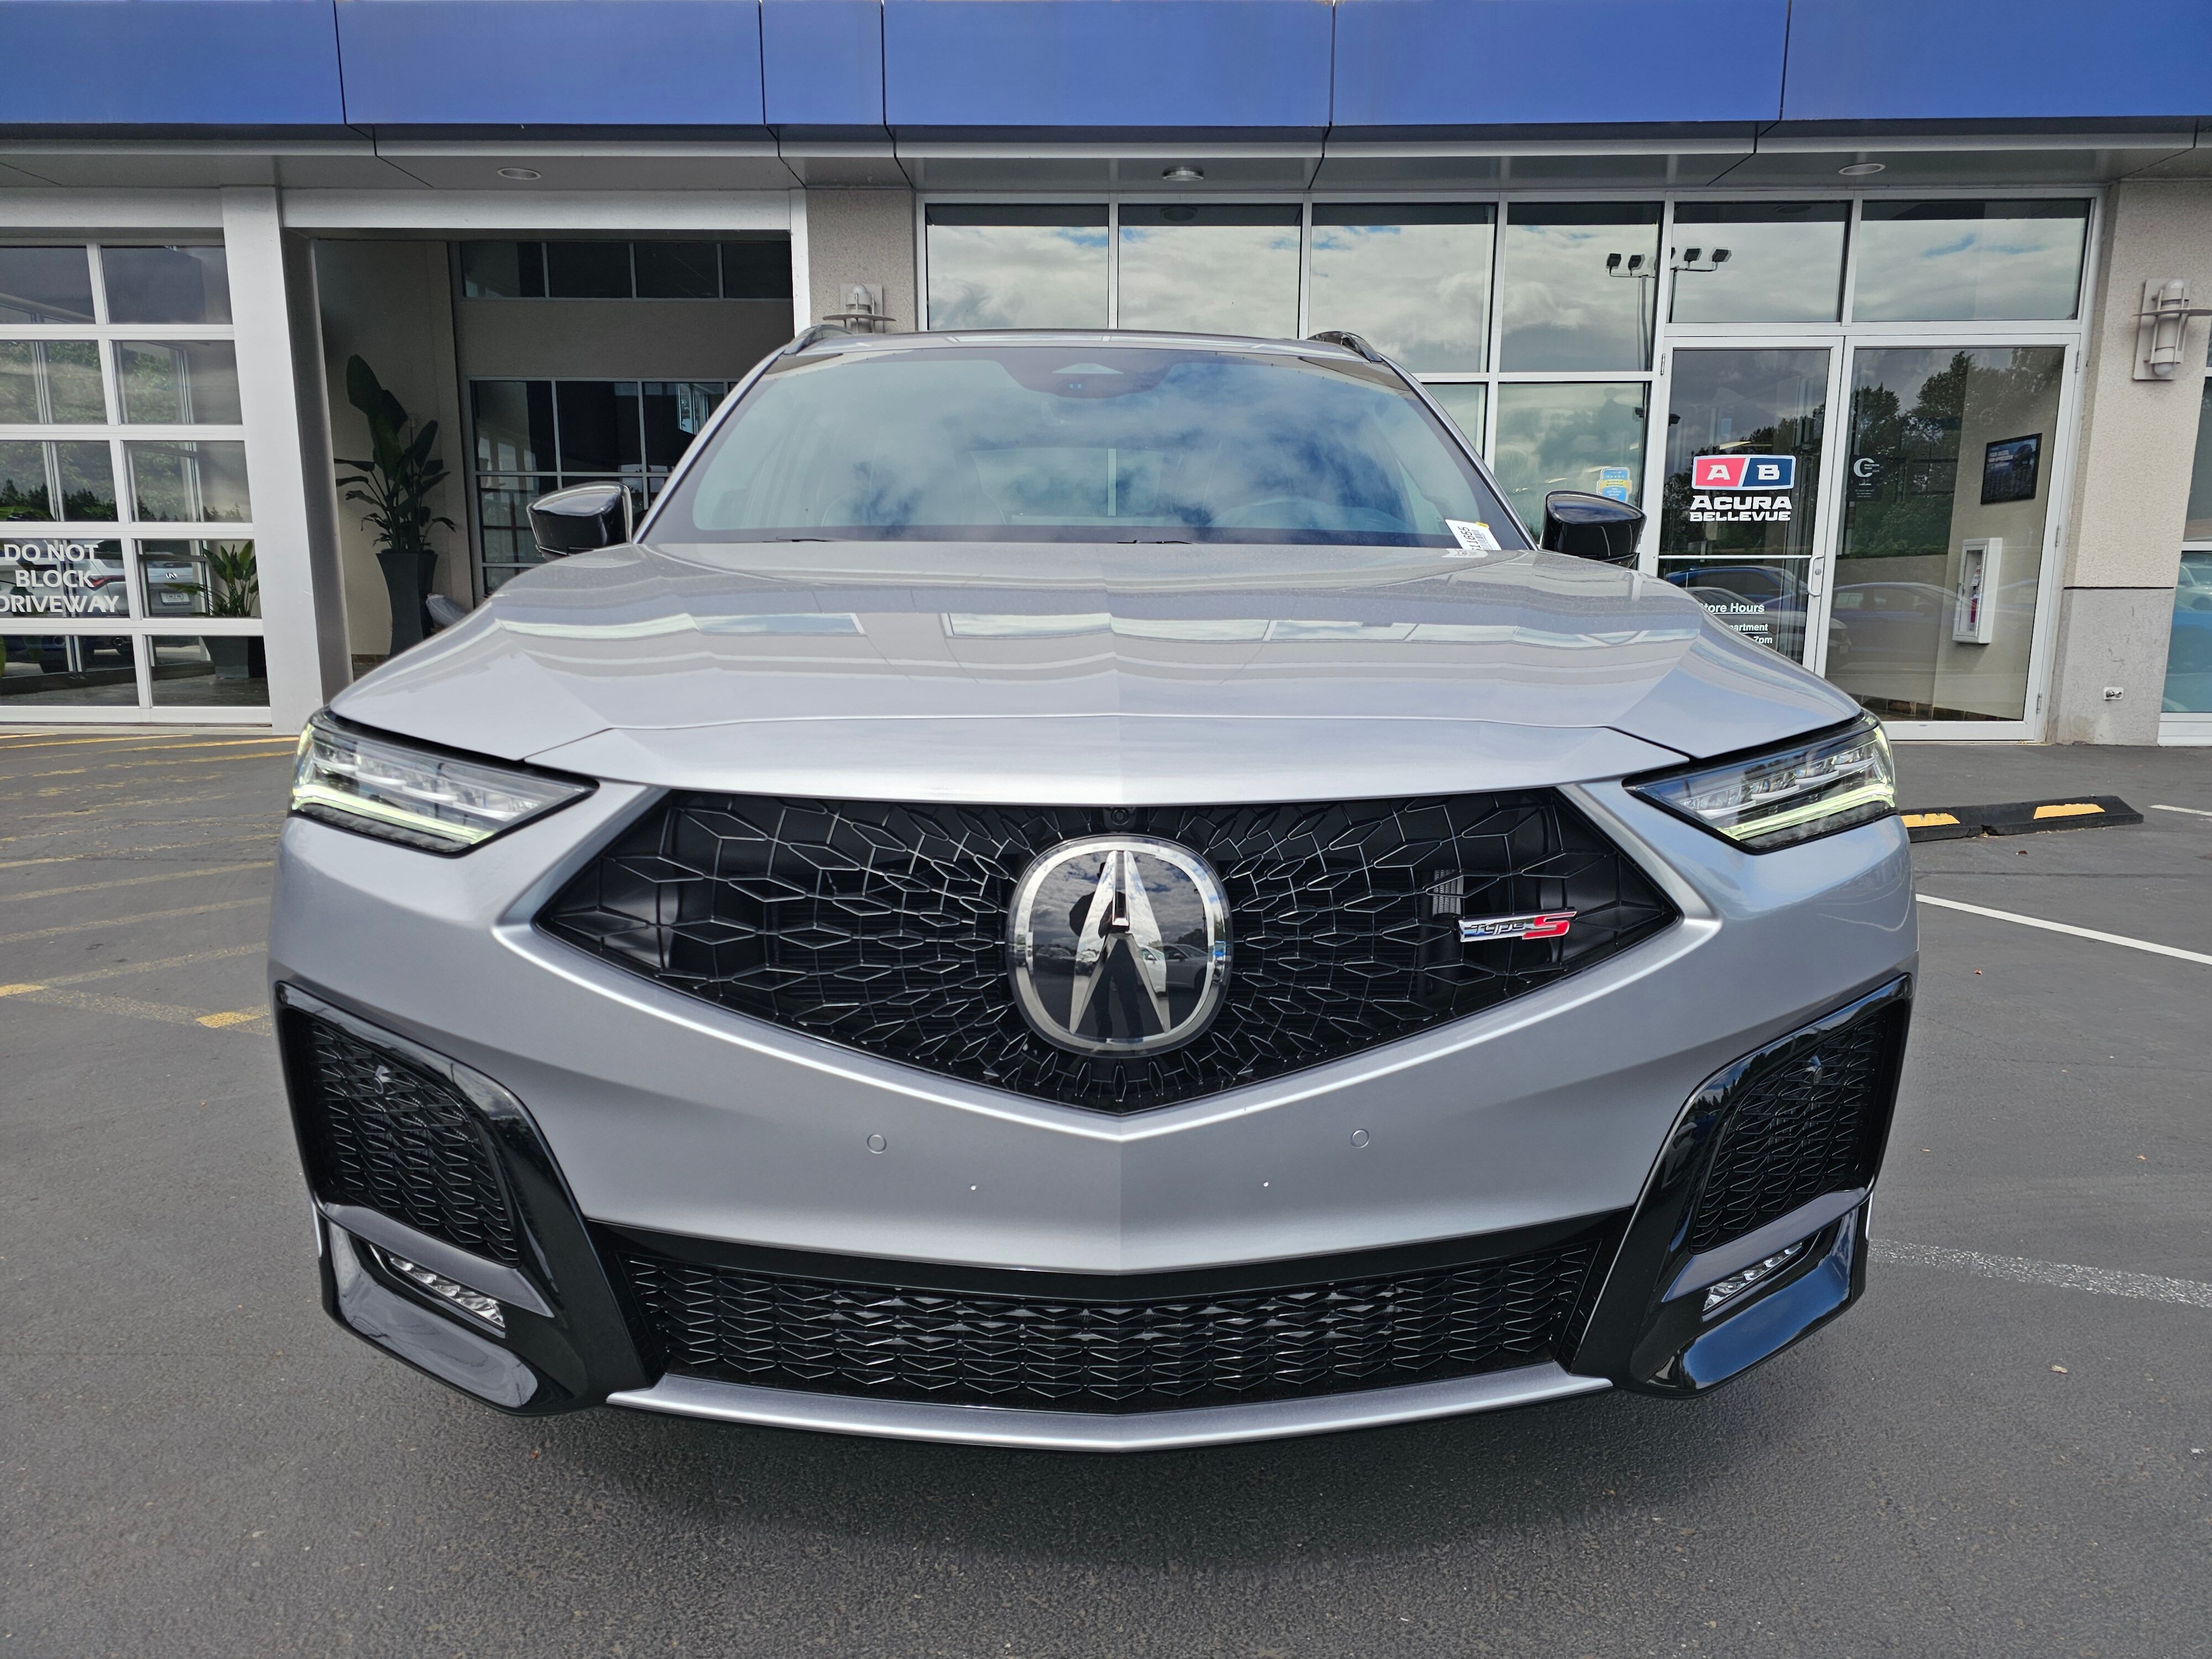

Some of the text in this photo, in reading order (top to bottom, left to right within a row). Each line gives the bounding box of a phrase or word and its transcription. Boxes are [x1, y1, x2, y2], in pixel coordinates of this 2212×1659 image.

[1707, 465, 1780, 481] A B
[1689, 495, 1792, 510] ACURA
[1689, 512, 1791, 522] BELLEVUE
[4, 544, 99, 562] DO NOT
[15, 570, 95, 588] BLOCK
[0, 595, 120, 613] DRIVEWAY
[1730, 602, 1766, 613] Hours
[1471, 911, 1577, 940] Type S
